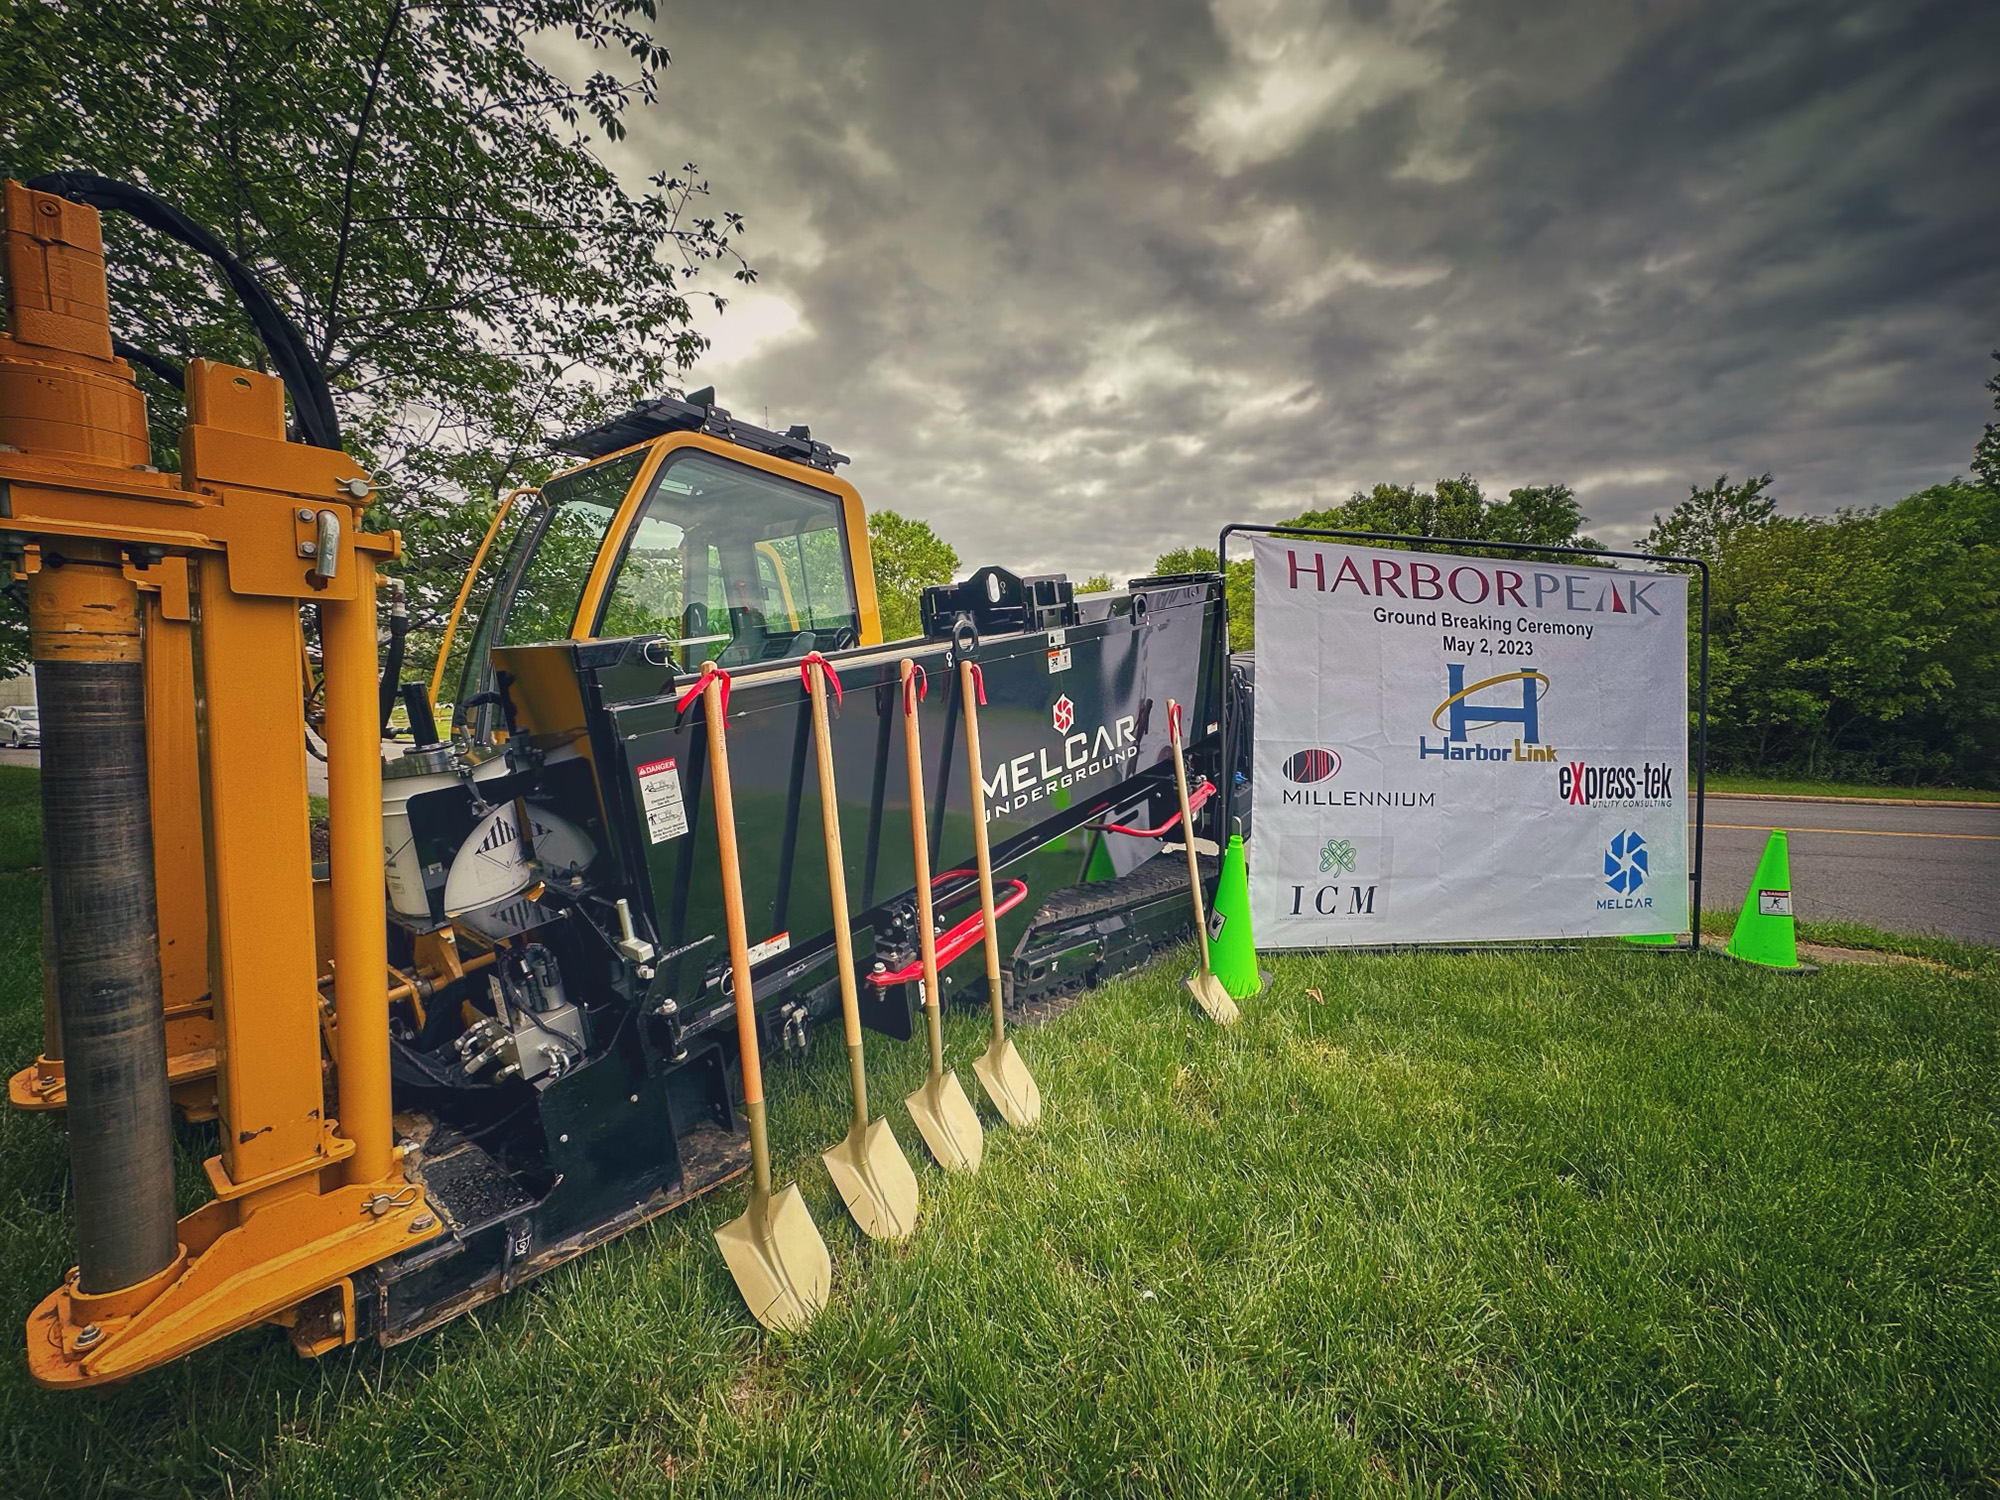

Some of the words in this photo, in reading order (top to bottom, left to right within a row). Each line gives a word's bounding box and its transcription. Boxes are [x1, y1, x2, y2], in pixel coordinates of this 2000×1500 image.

[1287, 550, 1661, 616] HARBORPEAK
[1373, 607, 1436, 626] Ground
[1441, 612, 1512, 634] Breaking
[1516, 617, 1594, 639] Ceremony
[1443, 636, 1475, 655] May
[1479, 639, 1493, 656] 2,
[1497, 640, 1534, 656] 2023
[645, 760, 676, 774] DANGER
[981, 715, 1137, 799] MELCAR
[1559, 762, 1673, 805] eXpress-tek
[1283, 789, 1435, 807] MILLENNIUM
[1592, 800, 1620, 808] UTILITY
[1622, 799, 1672, 808] CONSULTING
[1596, 897, 1653, 910] MELCAR
